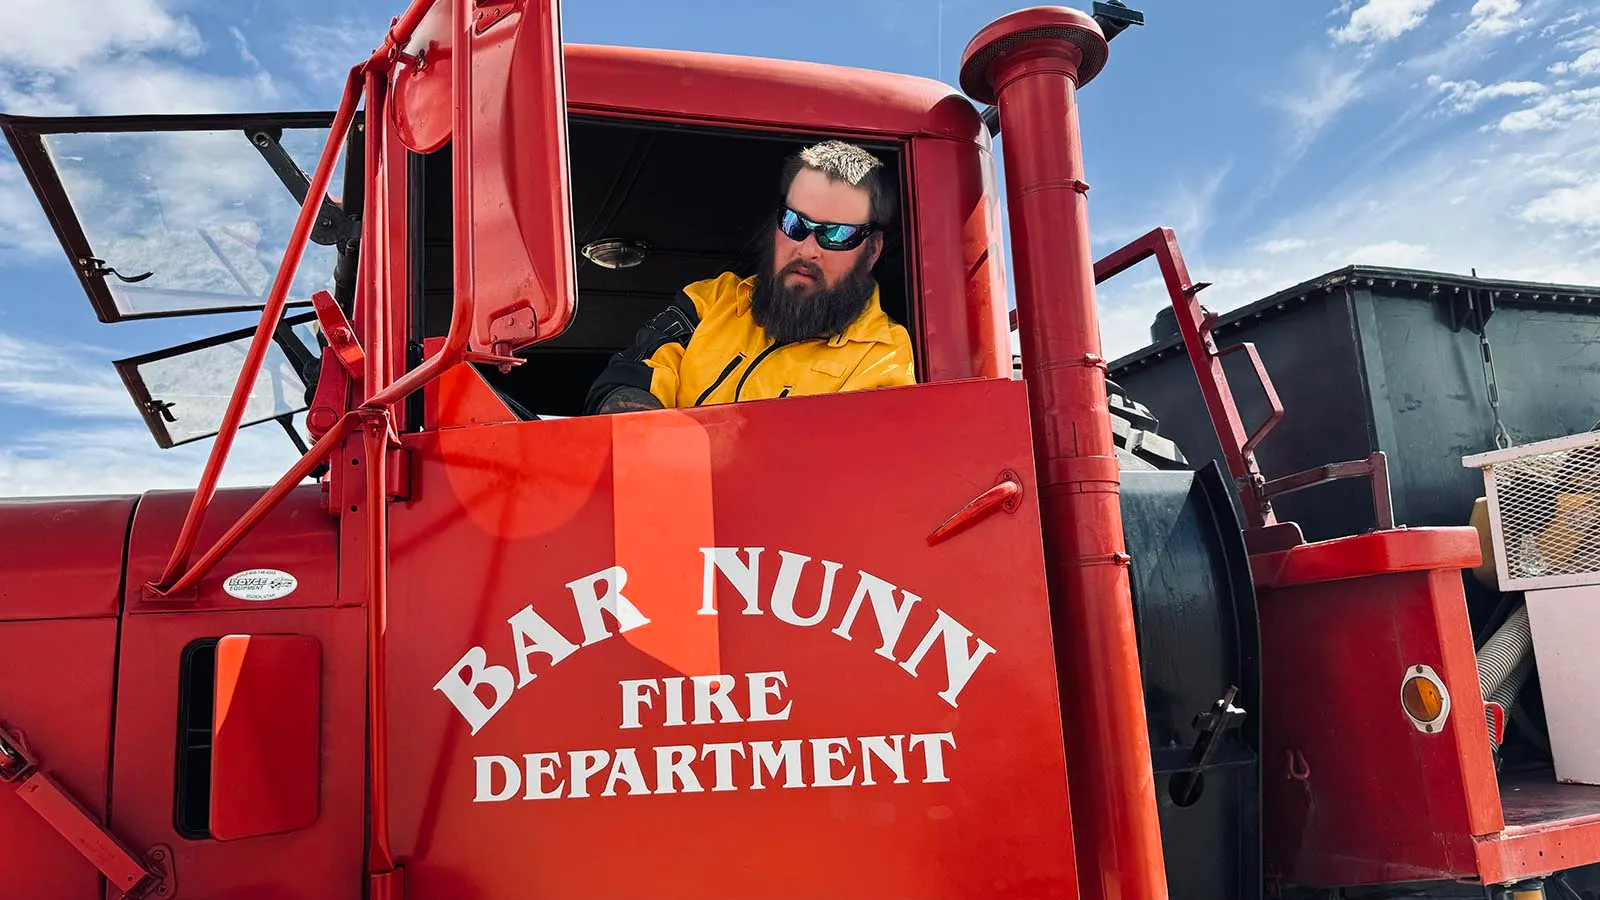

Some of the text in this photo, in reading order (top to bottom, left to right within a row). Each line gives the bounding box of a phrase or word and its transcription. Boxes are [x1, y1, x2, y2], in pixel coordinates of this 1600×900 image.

[433, 547, 996, 736] BAR NUNN
[619, 670, 792, 729] FIRE
[473, 731, 956, 802] DEPARTMENT
